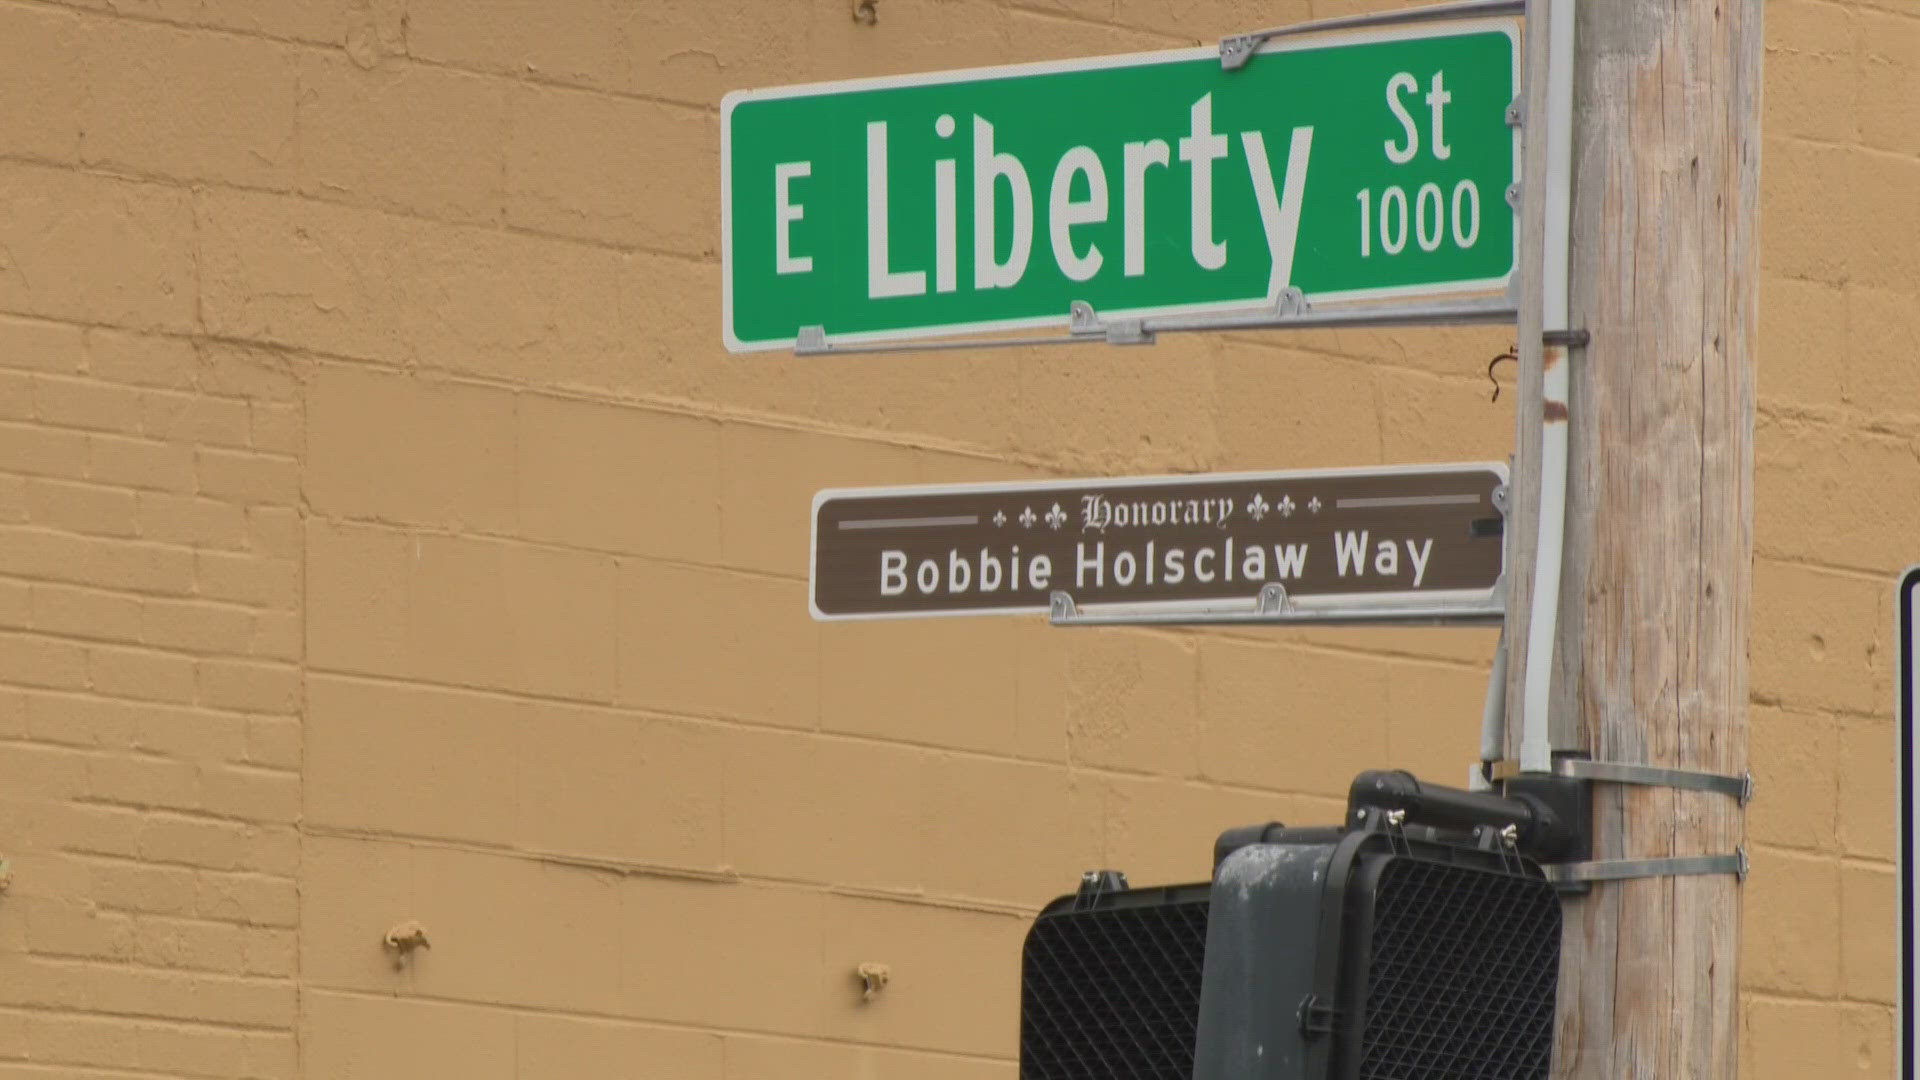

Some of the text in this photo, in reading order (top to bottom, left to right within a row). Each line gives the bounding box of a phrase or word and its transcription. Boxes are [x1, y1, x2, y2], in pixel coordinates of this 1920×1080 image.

[775, 69, 1451, 299] E Liberty St
[1356, 178, 1481, 258] 1000
[1080, 494, 1234, 533] Honorary
[880, 530, 1434, 596] Bobbie Holsclaw Way
